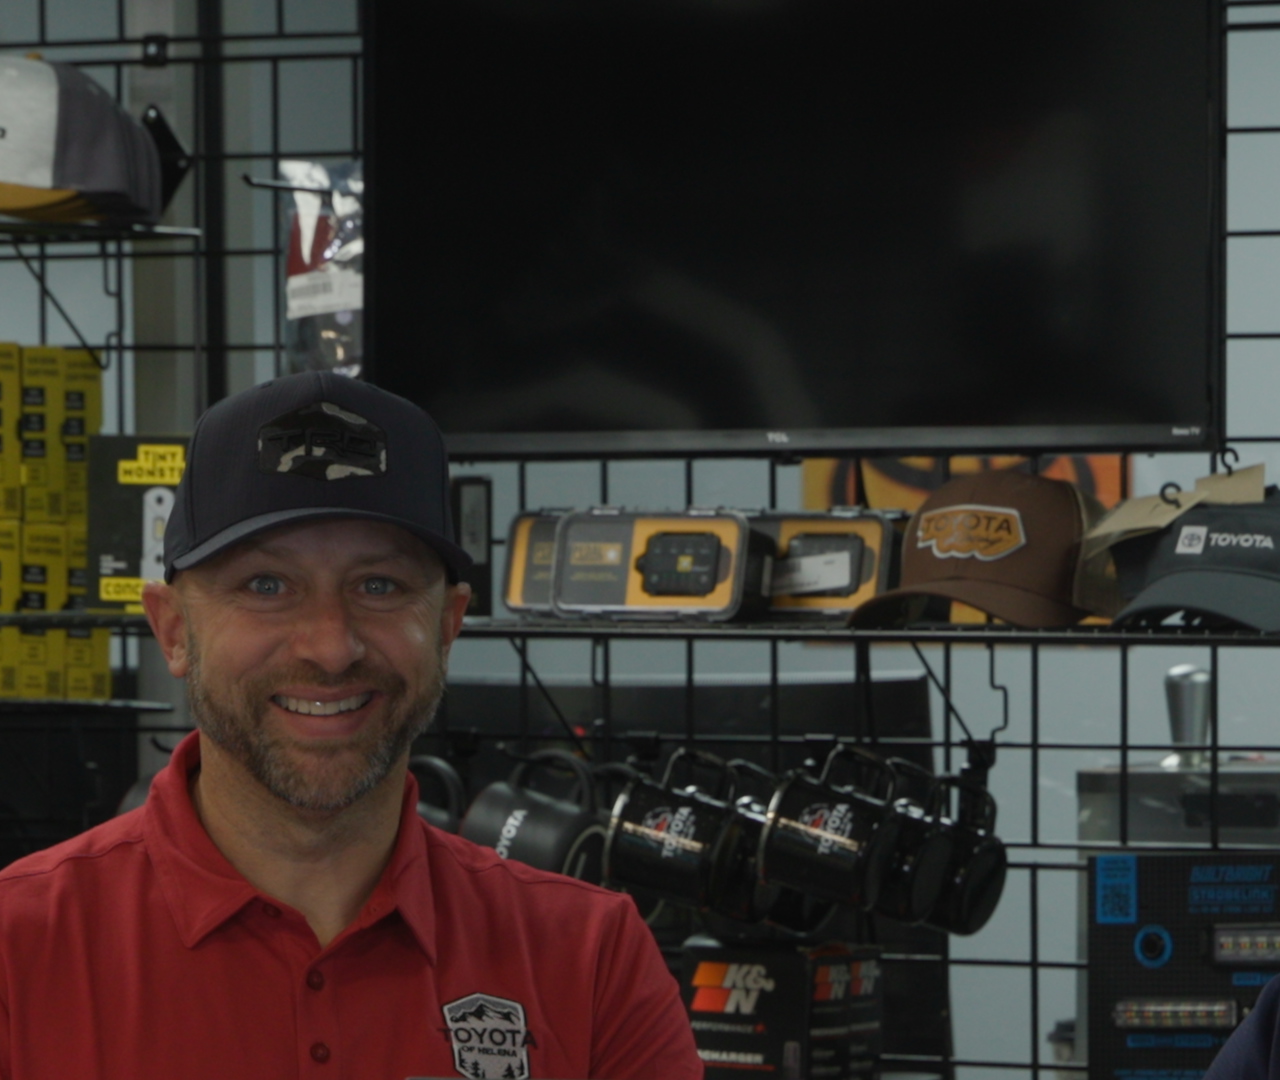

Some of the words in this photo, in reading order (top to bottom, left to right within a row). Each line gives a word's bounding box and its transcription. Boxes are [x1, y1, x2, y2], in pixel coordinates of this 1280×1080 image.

[267, 427, 378, 458] TRD
[123, 468, 184, 479] MONST
[923, 513, 1012, 535] TOYOTA
[1209, 532, 1274, 550] TOYOTA
[104, 582, 142, 595] CONC
[495, 808, 529, 859] OYOTA
[661, 806, 694, 859] TOYOTA
[817, 803, 851, 855] TOYOTA
[437, 1027, 538, 1050] TOYOTA
[477, 1046, 518, 1059] HELENA
